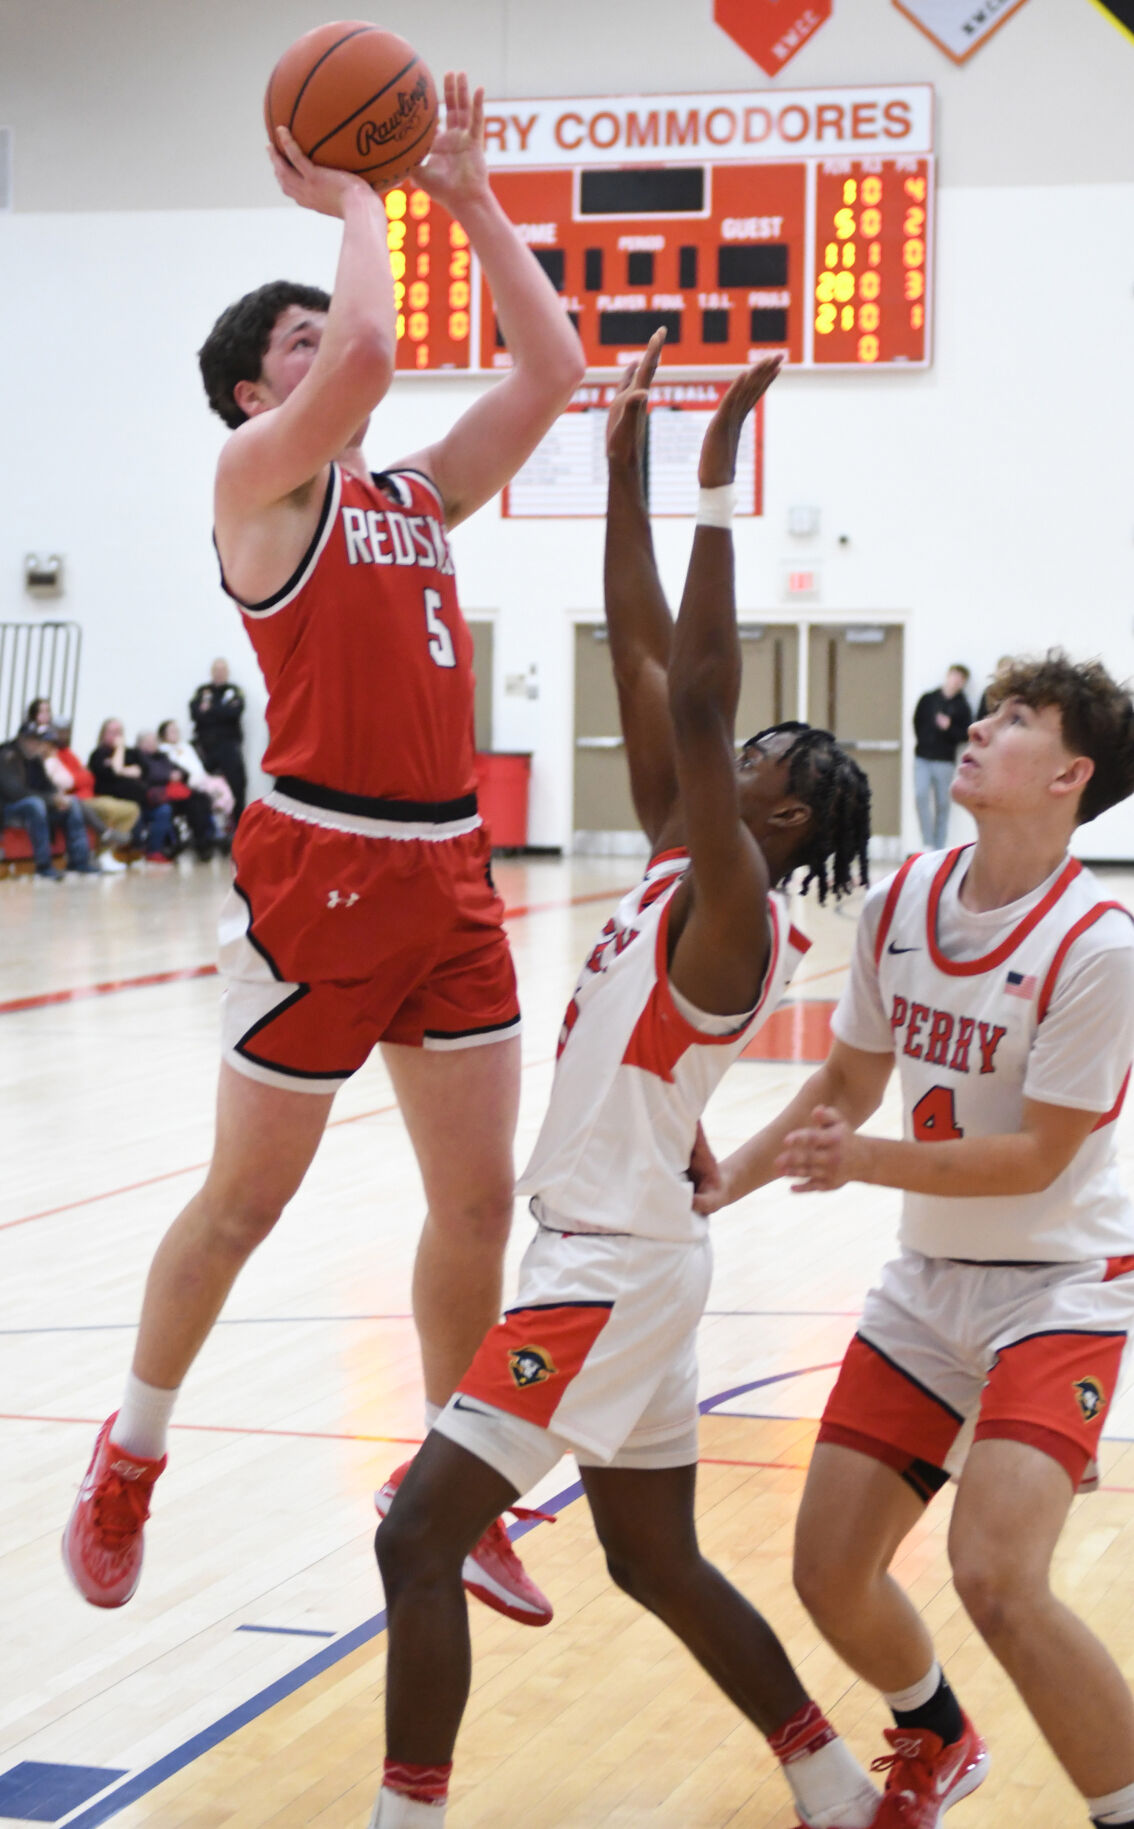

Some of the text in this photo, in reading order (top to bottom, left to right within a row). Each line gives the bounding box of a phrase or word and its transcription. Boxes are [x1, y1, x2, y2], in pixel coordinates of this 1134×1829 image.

[553, 100, 913, 150] COMMODORES
[861, 176, 883, 207] 0
[512, 223, 557, 244] OME
[721, 216, 783, 240] GUEST
[860, 207, 882, 239] 0
[904, 206, 926, 237] 2
[450, 250, 471, 281] 2
[903, 238, 925, 270] 0
[408, 281, 430, 312] 0
[449, 280, 471, 311] 0
[859, 270, 881, 301] 0
[408, 311, 430, 342] 0
[449, 310, 471, 342] 0
[858, 302, 880, 334] 0
[857, 334, 880, 364] 0
[424, 587, 456, 668] 5
[891, 995, 1006, 1075] PERRY
[912, 1085, 963, 1142] 4
